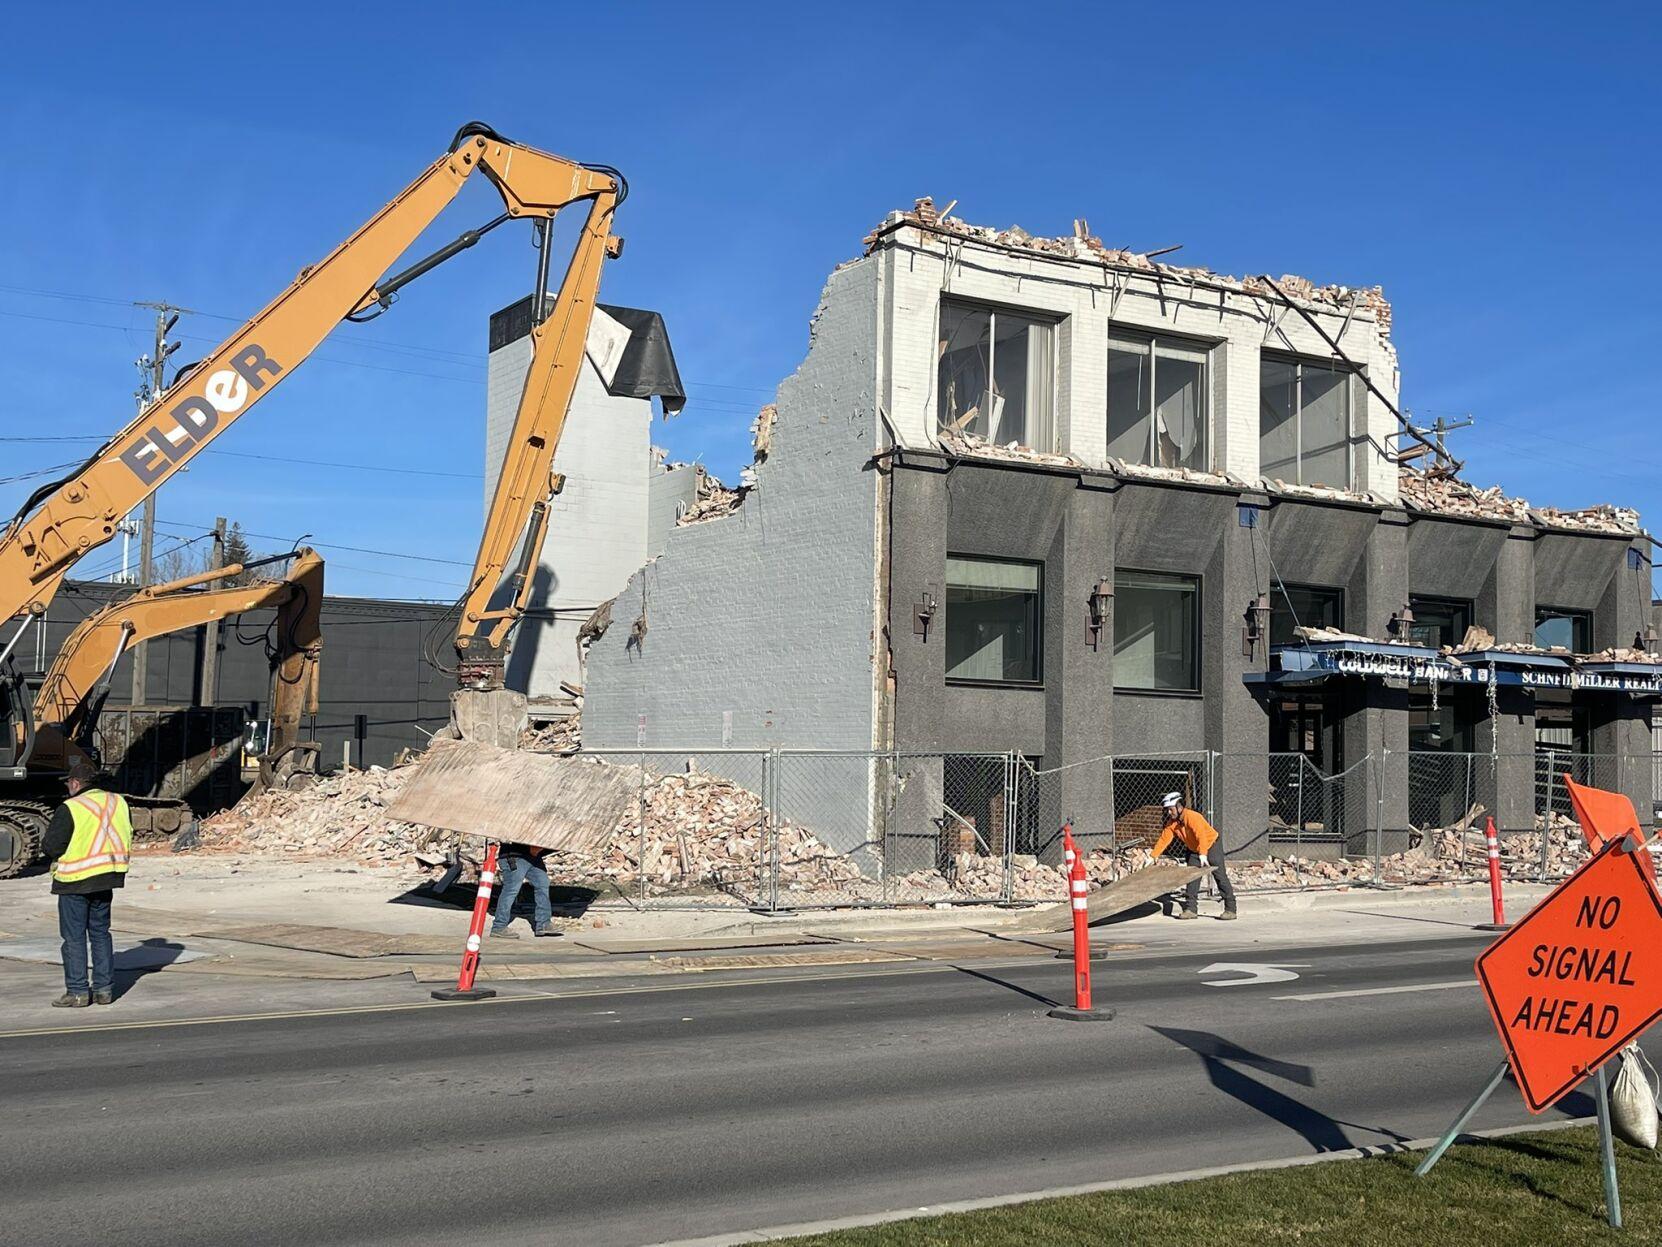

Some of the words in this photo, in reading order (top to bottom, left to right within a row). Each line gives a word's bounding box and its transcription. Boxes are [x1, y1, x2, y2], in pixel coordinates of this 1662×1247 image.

[1415, 665, 1472, 681] BANR
[1575, 895, 1621, 930] NO
[1527, 944, 1636, 986] SIGNAL
[1511, 996, 1620, 1040] AHEAD
